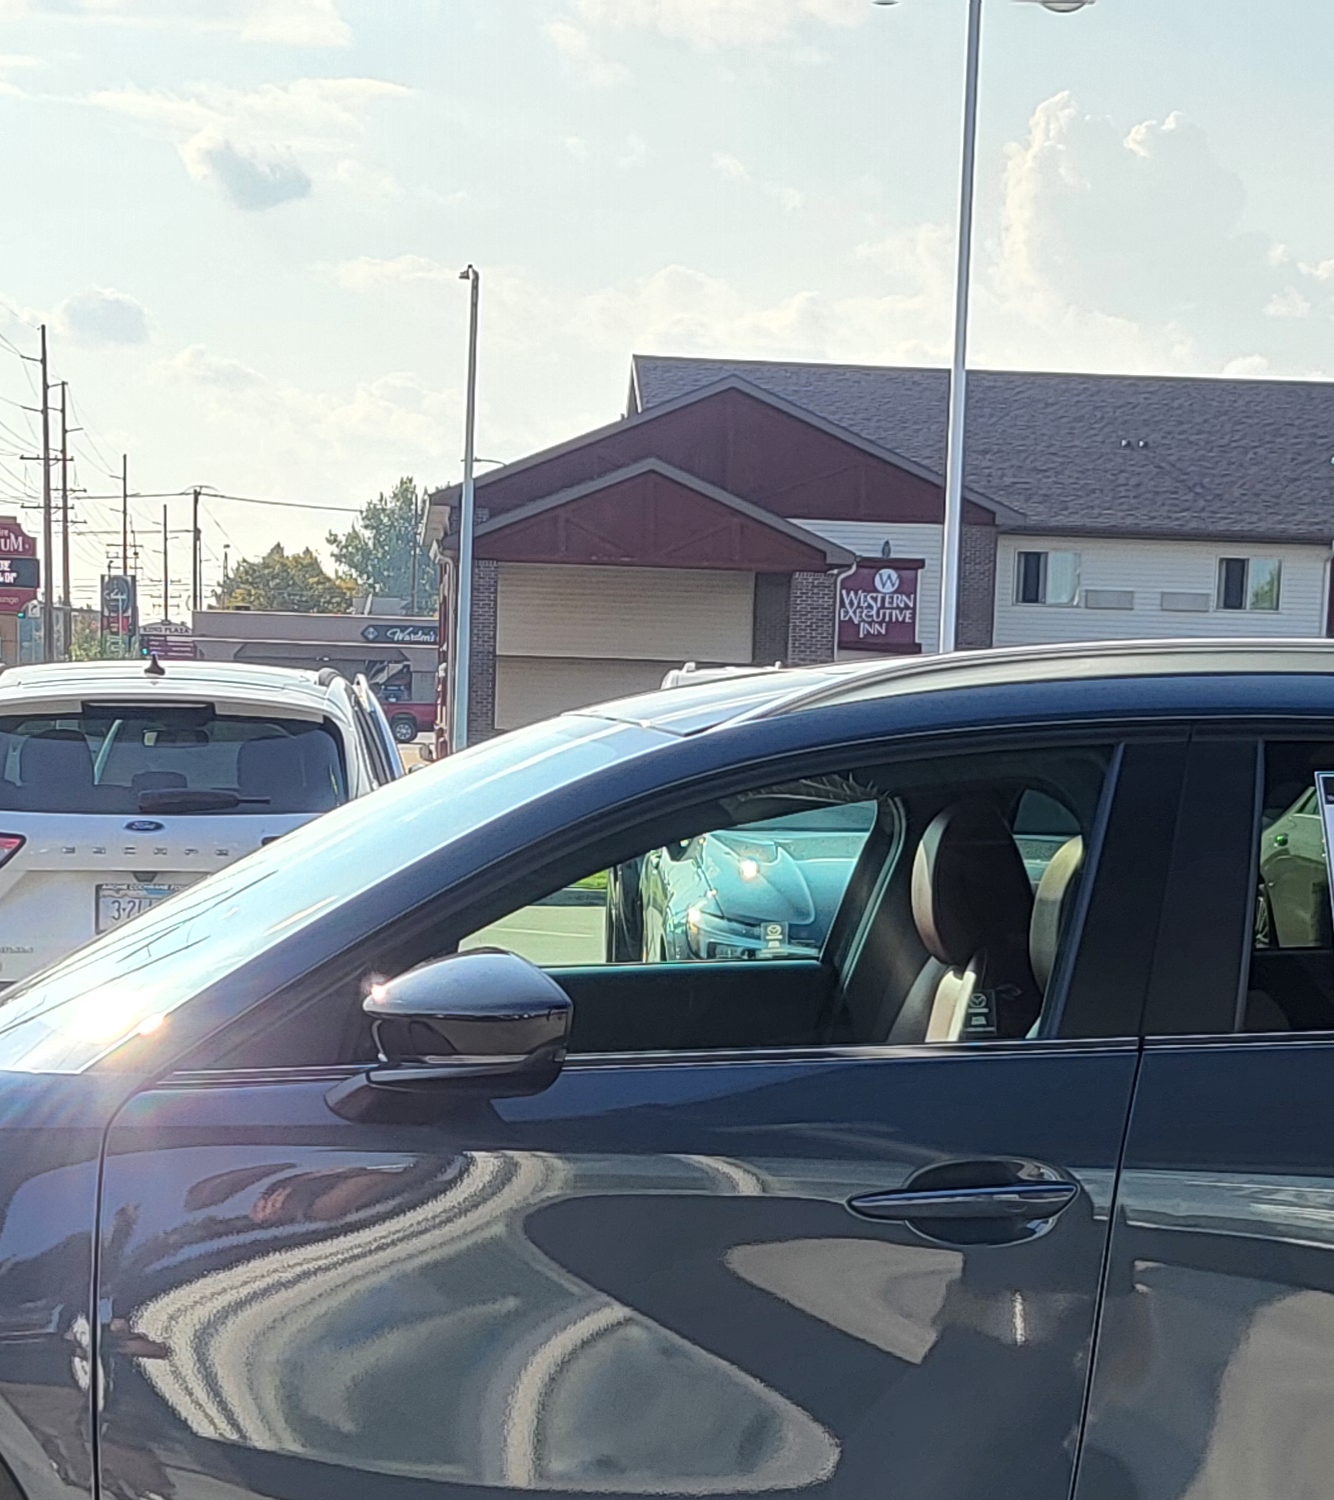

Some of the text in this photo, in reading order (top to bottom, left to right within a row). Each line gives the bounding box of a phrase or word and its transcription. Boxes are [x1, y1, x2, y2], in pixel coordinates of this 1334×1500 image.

[879, 573, 898, 589] W
[842, 590, 915, 609] WESTERN
[840, 608, 913, 624] EXECUTIVE
[859, 622, 887, 638] INN
